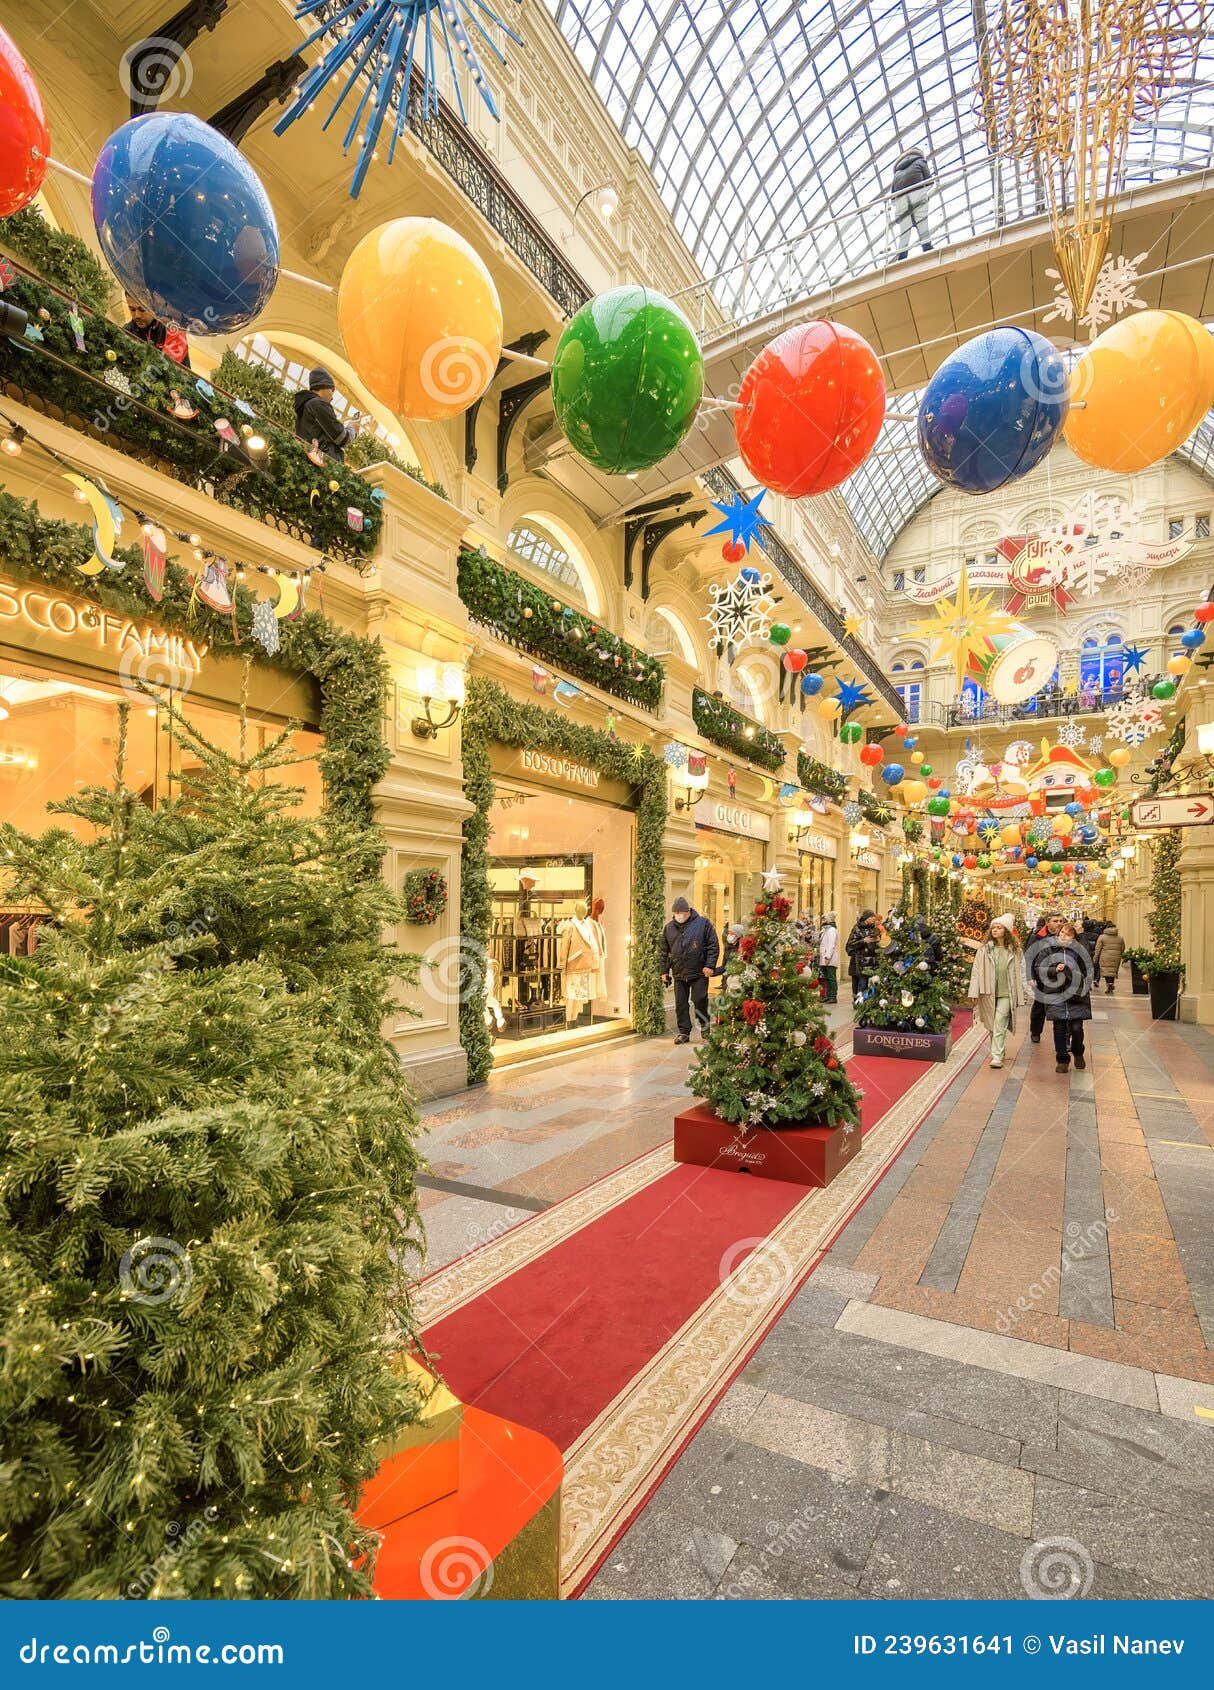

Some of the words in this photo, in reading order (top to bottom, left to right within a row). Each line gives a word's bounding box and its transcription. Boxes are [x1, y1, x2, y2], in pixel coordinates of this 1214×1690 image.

[968, 570, 1004, 579] агазин
[100, 614, 209, 673] FAMILY
[521, 749, 563, 778] BOSCO
[567, 761, 601, 788] FAMILY
[716, 803, 752, 829] GUCCI
[867, 1034, 931, 1049] LONGINES
